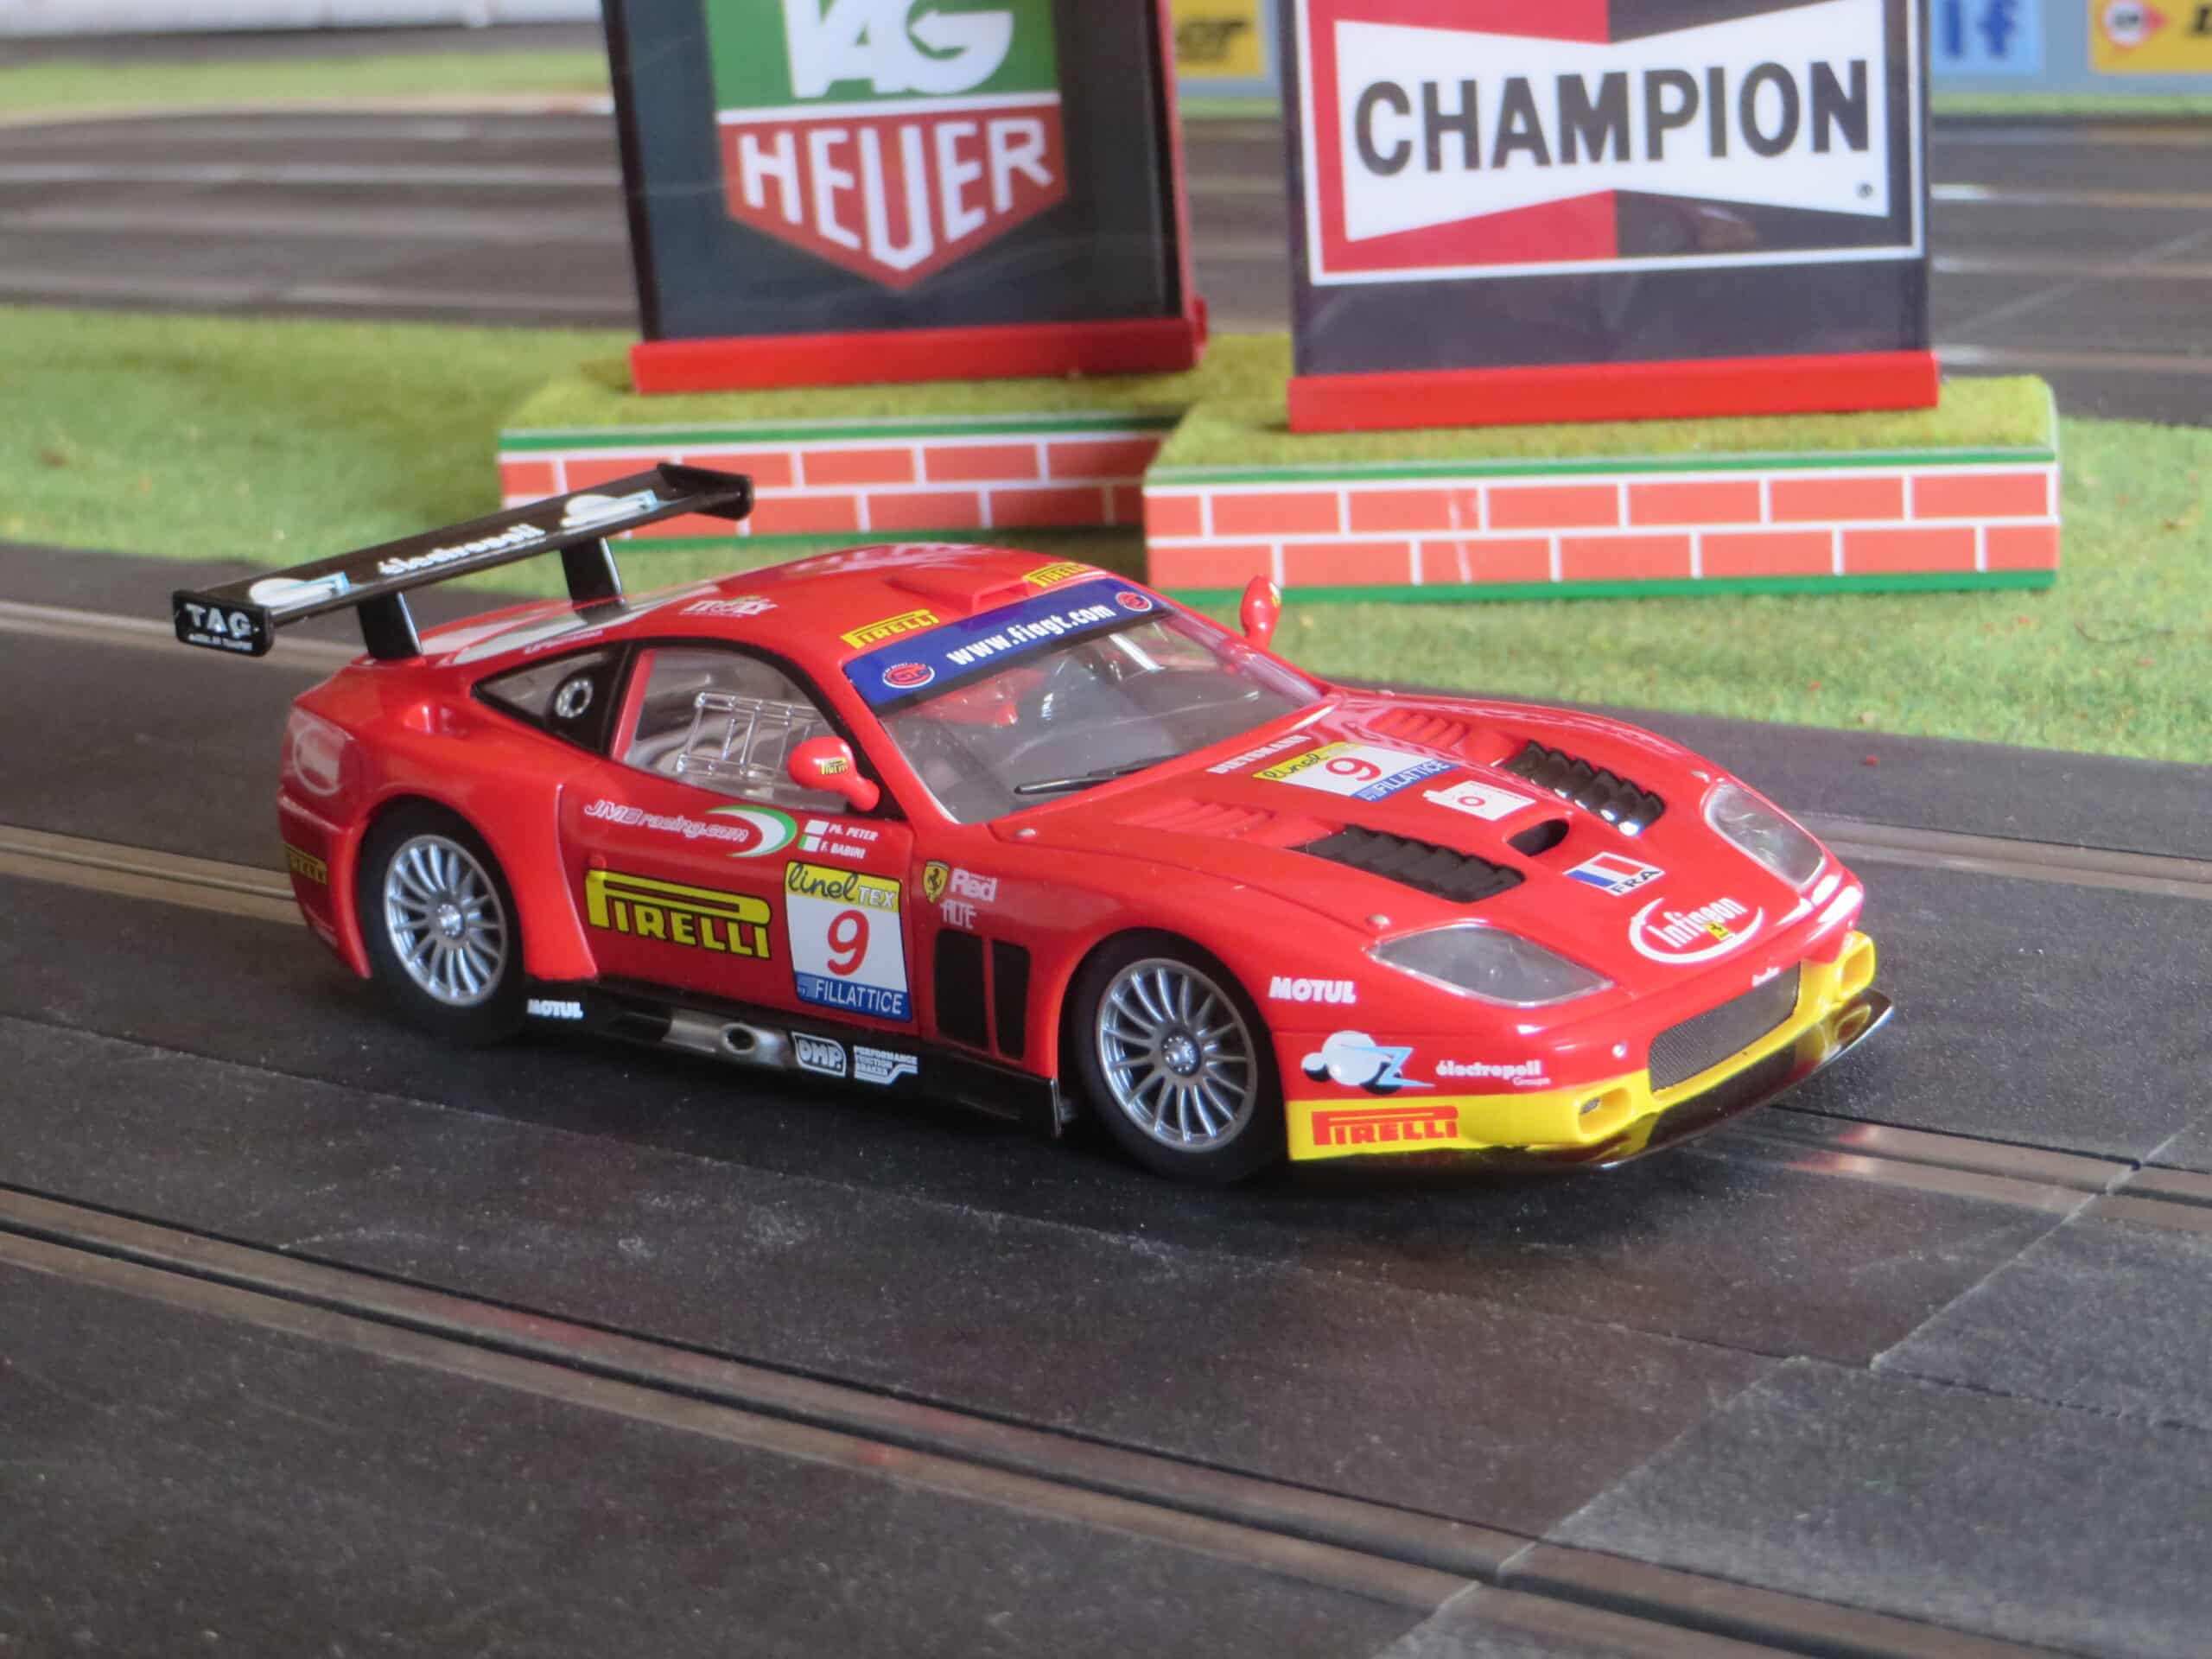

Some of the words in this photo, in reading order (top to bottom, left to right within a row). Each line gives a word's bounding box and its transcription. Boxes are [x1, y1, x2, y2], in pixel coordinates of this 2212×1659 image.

[1353, 59, 1872, 178] CHAMPION
[738, 118, 1053, 270] HEUER
[185, 603, 251, 639] TAG
[840, 608, 940, 650] PIRELLI
[946, 604, 1116, 665] www.fiagt.com
[1325, 757, 1382, 782] 9
[1610, 868, 1661, 894] FRA
[584, 868, 772, 960] PIRELLI
[826, 908, 871, 976] 9
[527, 998, 584, 1019] MOTUL
[815, 978, 904, 1016] FILLATTICE
[1268, 976, 1357, 1005] MOTUL
[1311, 1105, 1459, 1147] PIRELLI
